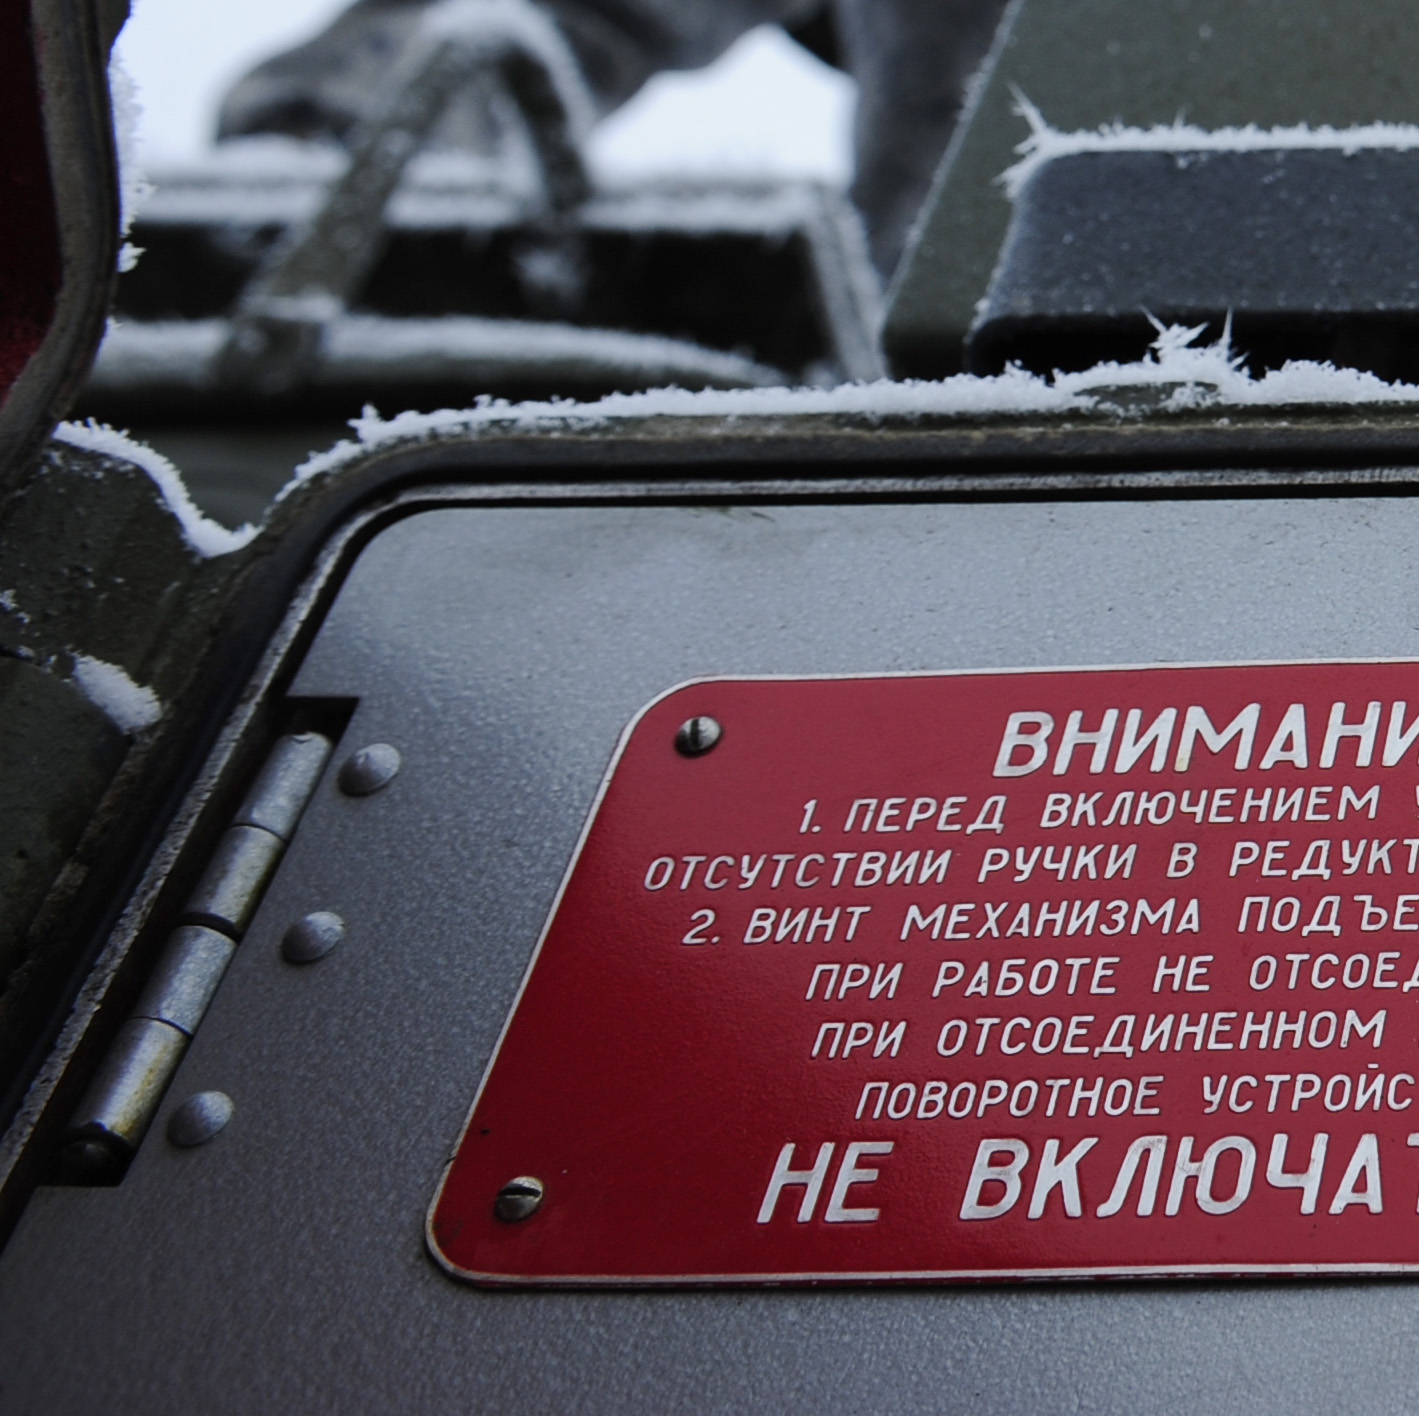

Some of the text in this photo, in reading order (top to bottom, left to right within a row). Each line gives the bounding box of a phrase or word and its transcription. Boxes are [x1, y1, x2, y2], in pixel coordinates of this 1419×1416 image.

[799, 799, 824, 833] 1.
[843, 795, 1007, 835] ПЕРЕД
[1039, 784, 1381, 828] ВКЛЮЧЕНИЕМ
[644, 849, 952, 891] ОТСУТСТВИИ
[977, 843, 1137, 883] РУЧКИ
[1166, 842, 1198, 878] В
[682, 909, 722, 945] 2.
[743, 906, 873, 944] ВИНТ
[900, 897, 1200, 940] МЕХАНИЗМА
[805, 962, 903, 1000] ПРИ
[932, 956, 1121, 998] РАБОТЕ
[1152, 954, 1214, 993] НЕ
[811, 1020, 907, 1058] ПРИ
[937, 1009, 1388, 1058] ОТСОЕДИНЕННОМ
[855, 1075, 1164, 1119] ПОВОРОТНОЕ
[757, 1141, 894, 1223] НЕ
